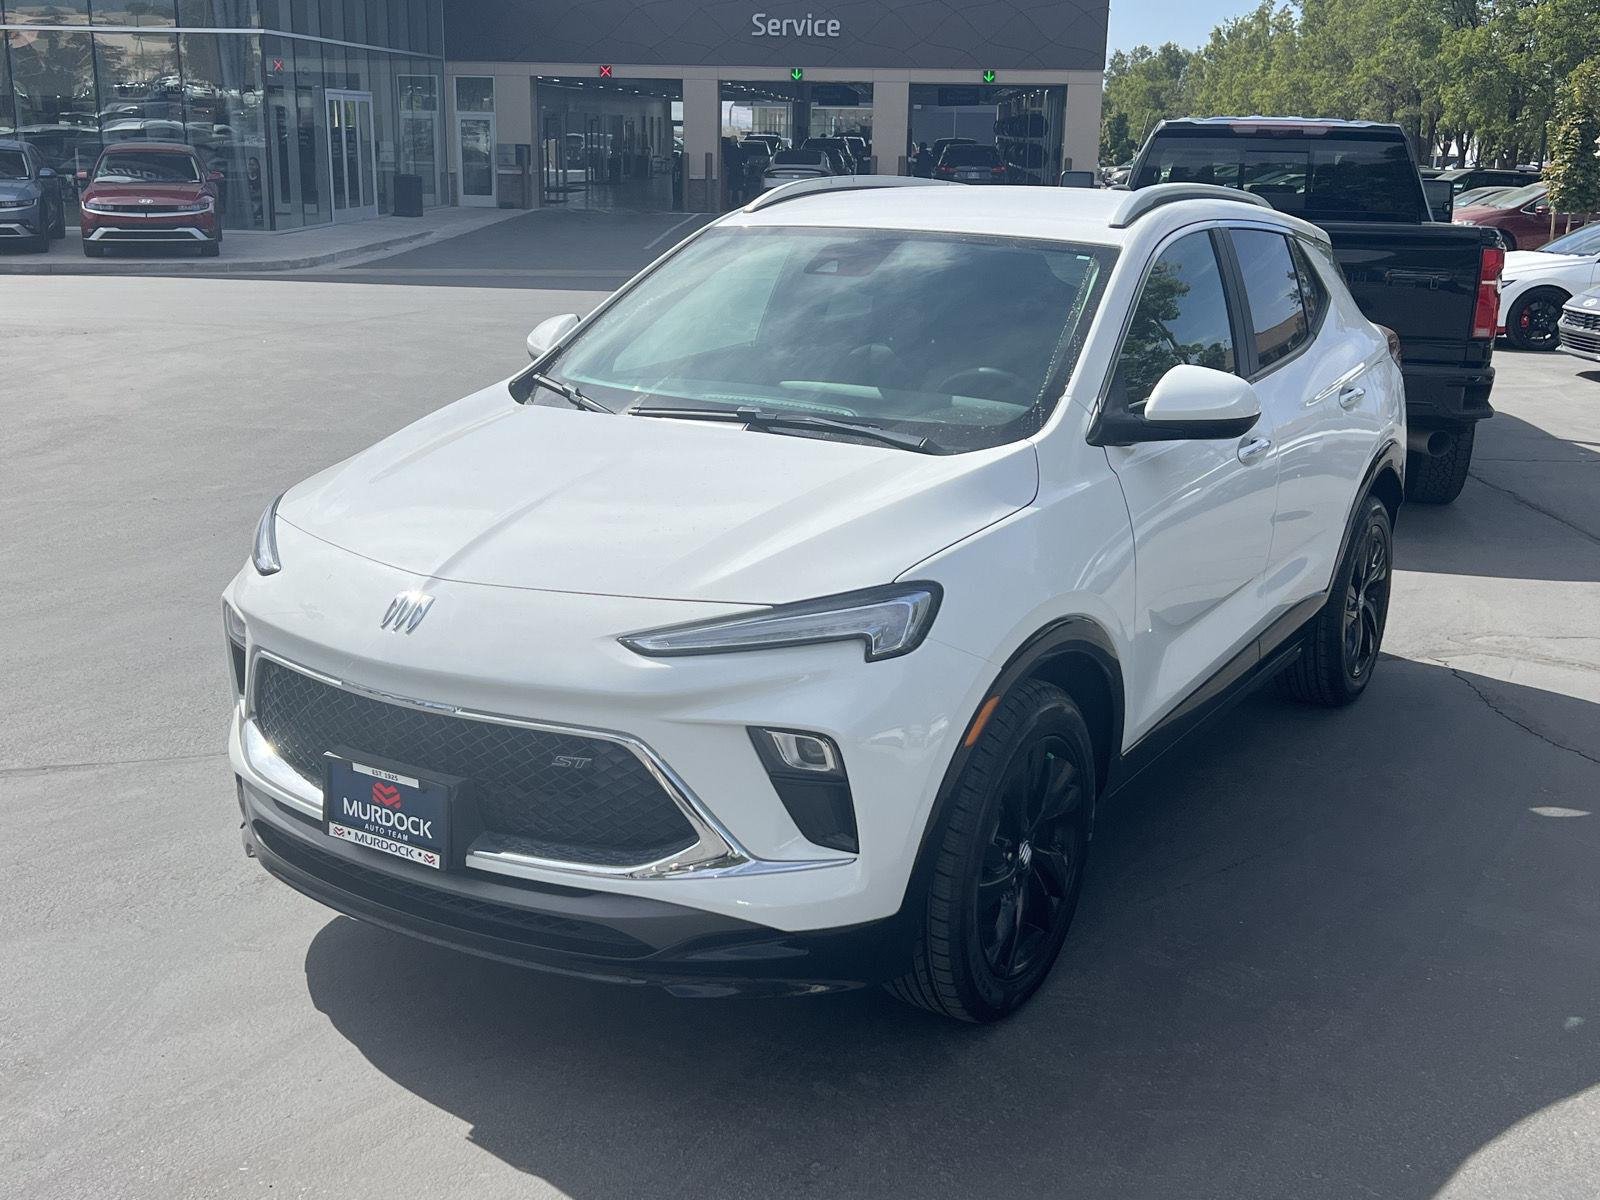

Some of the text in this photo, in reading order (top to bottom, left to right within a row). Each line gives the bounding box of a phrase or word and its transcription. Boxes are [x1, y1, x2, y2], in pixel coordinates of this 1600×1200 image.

[751, 13, 841, 37] Service
[551, 755, 593, 769] ST
[371, 769, 399, 782] EST 1925
[342, 797, 433, 839] MURDOCK
[364, 823, 409, 841] AUTO TEAM
[354, 832, 415, 859] MURDOCK
